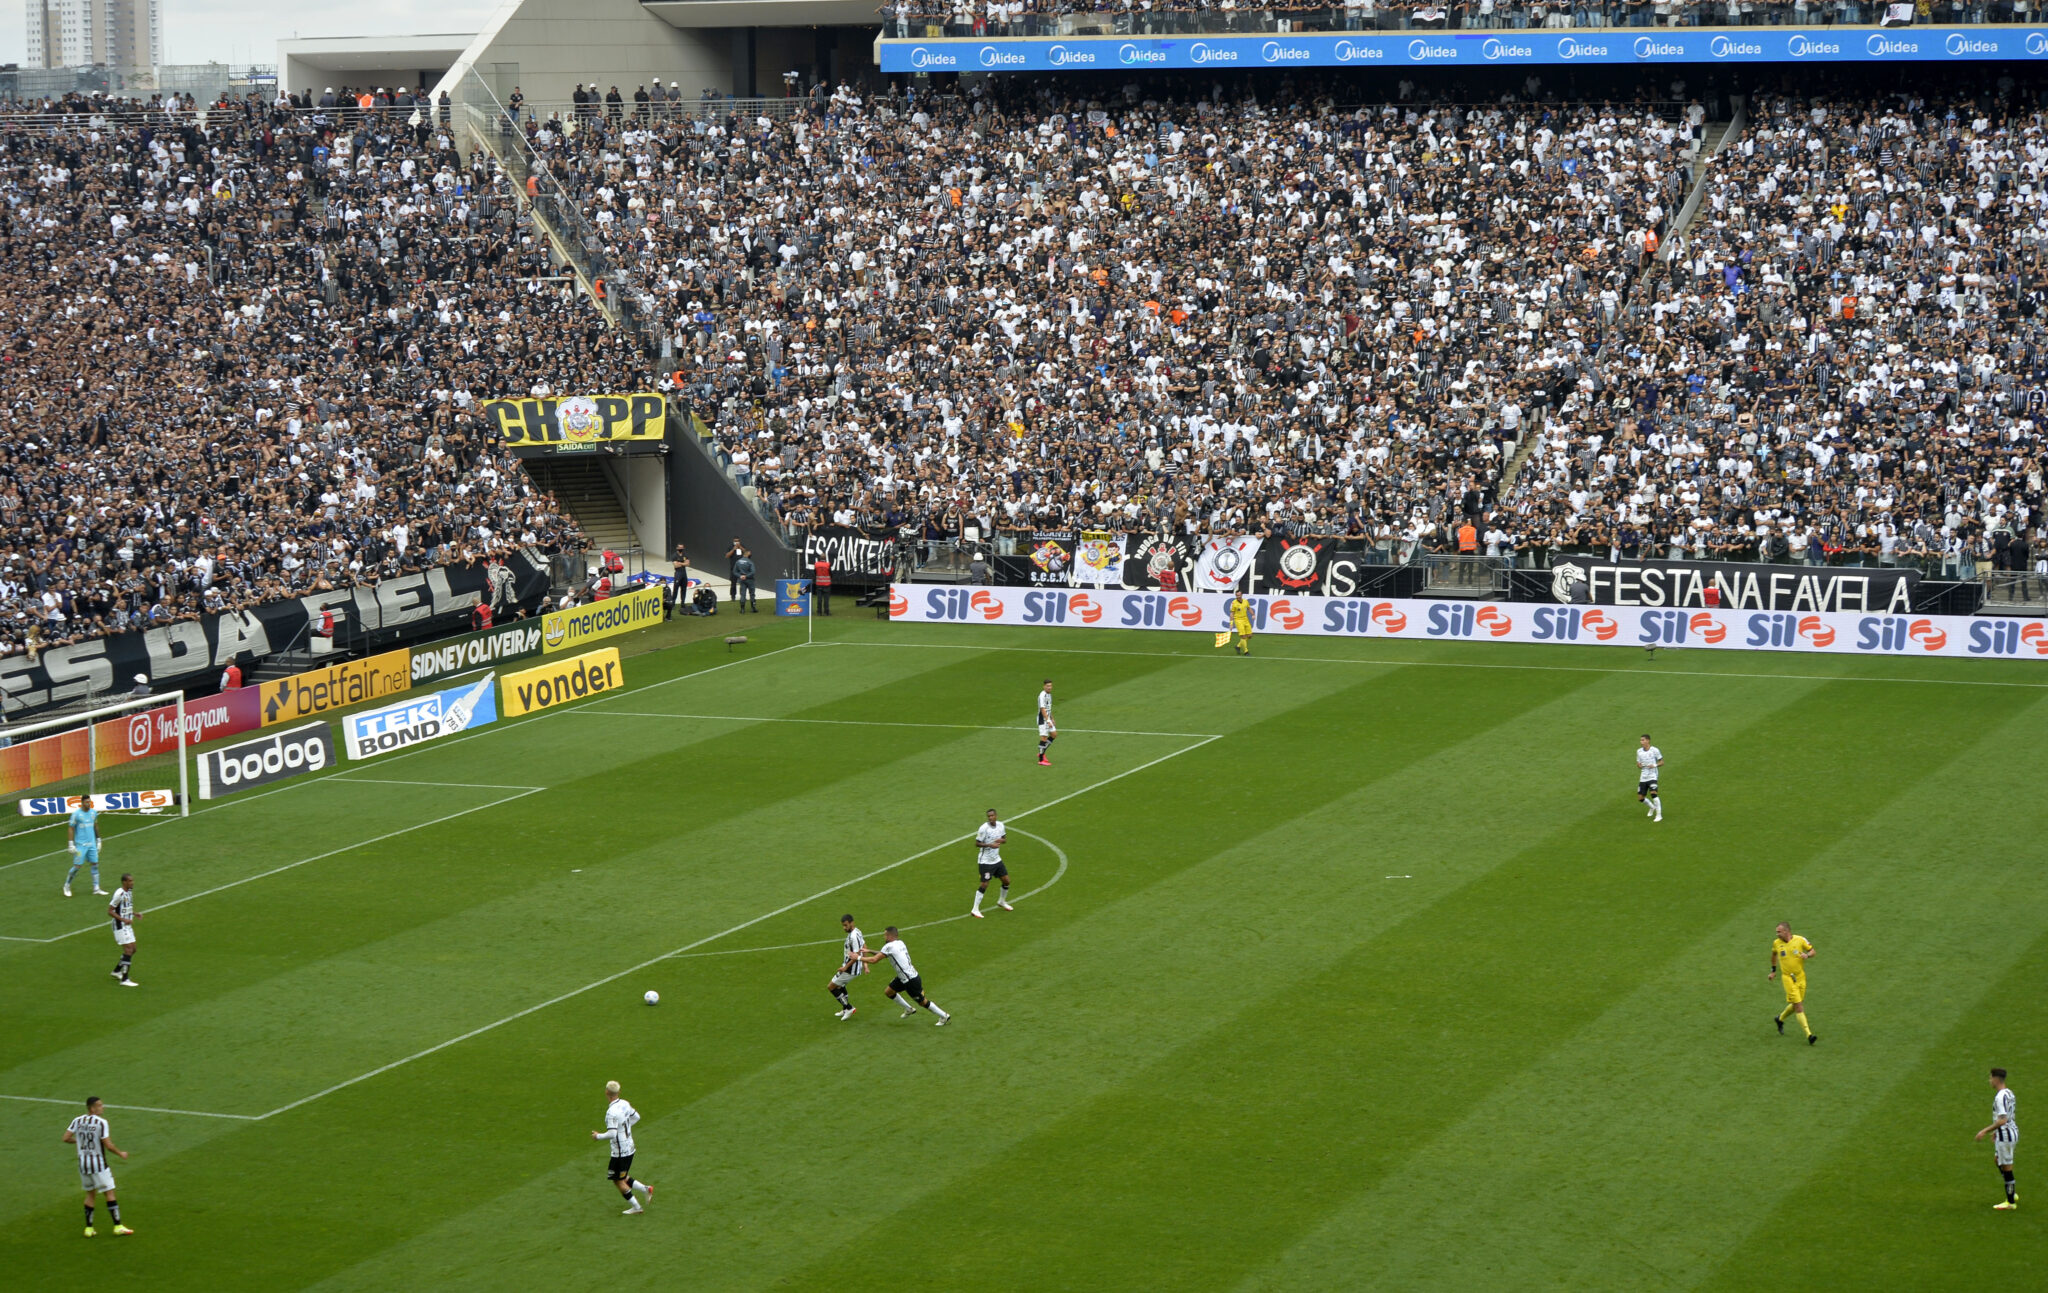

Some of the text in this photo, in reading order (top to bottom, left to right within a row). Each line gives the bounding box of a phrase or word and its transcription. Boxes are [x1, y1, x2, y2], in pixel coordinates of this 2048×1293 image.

[919, 53, 957, 66] Midea
[987, 52, 1026, 65] Midea
[1057, 51, 1096, 64] Midea
[1128, 50, 1167, 63] Midea
[1199, 49, 1238, 62] Midea
[1271, 47, 1310, 61] Midea
[1344, 46, 1384, 60] Midea
[1417, 45, 1458, 59] Midea
[1491, 44, 1533, 58] Midea
[1566, 43, 1608, 57] Midea
[1643, 42, 1685, 57] Midea
[1719, 41, 1762, 56] Midea
[1797, 40, 1840, 55] Midea
[1875, 39, 1919, 54] Midea
[1955, 38, 1999, 54] Midea
[805, 534, 895, 575] ESCANTEIO
[1134, 535, 1159, 559] PADOCA
[1163, 533, 1175, 544] DA
[926, 588, 969, 620] Sil
[1589, 566, 1912, 614] FESTA NA FAVELA
[568, 595, 661, 638] mercado livre
[1023, 591, 1067, 623] Sil
[1121, 594, 1165, 627] Sil
[1323, 600, 1369, 633] Sil
[1426, 603, 1475, 637] Sil
[144, 609, 272, 680] DA
[301, 567, 485, 640] FIEL
[1531, 607, 1580, 640] Sil
[1638, 610, 1688, 644] Sil
[1746, 613, 1797, 647] Sil
[1857, 617, 1908, 651] Sil
[1968, 620, 2020, 654] Sil
[411, 642, 468, 680] SIDNEY
[297, 661, 407, 714] betfair.net
[517, 659, 615, 712] vonder
[157, 706, 230, 743] Insagram
[359, 701, 433, 737] TEK
[358, 720, 440, 756] BOND
[219, 736, 326, 786] bodog
[29, 797, 66, 815] Sil
[105, 792, 140, 810] Sil
[79, 1131, 96, 1150] 28
